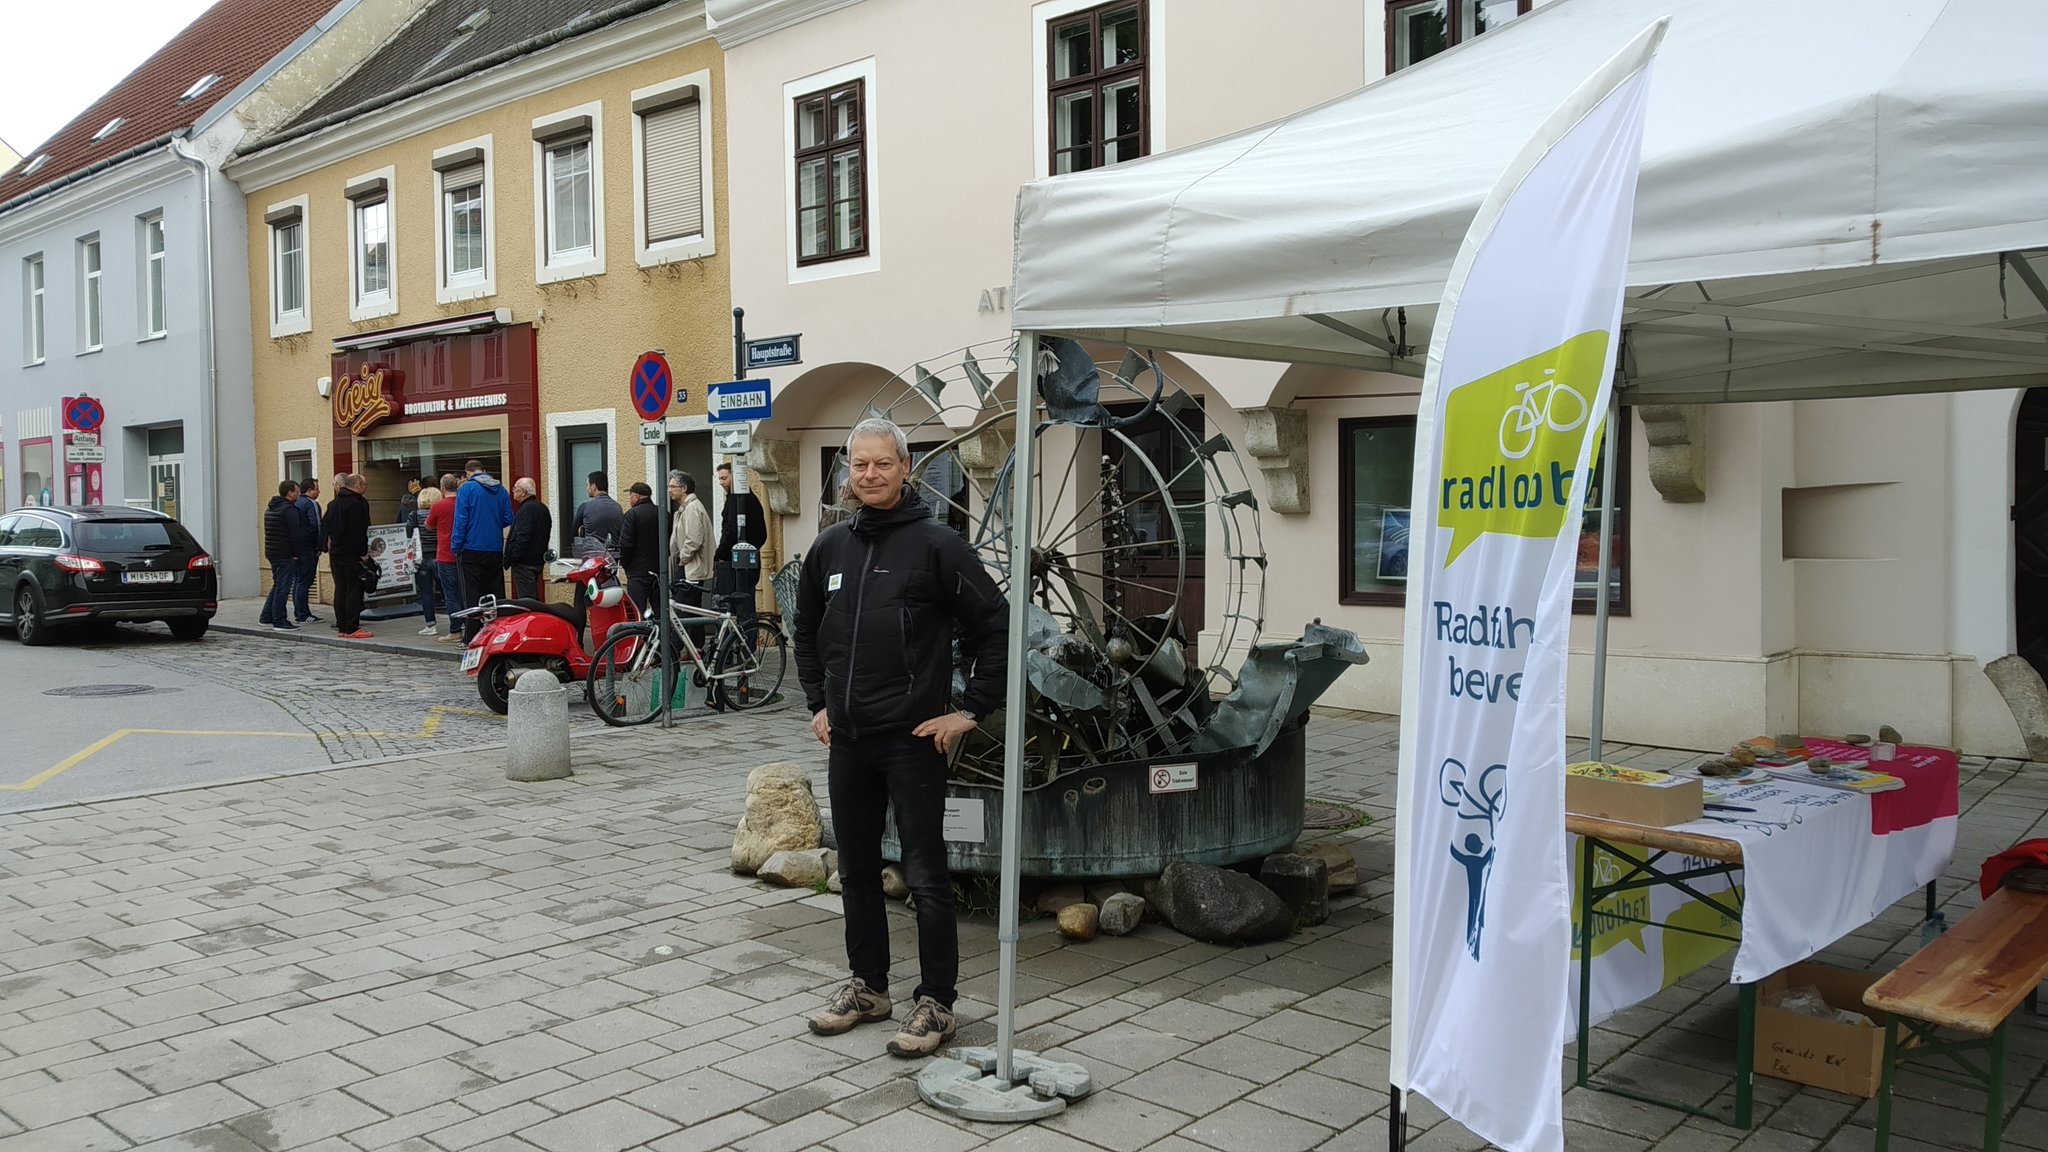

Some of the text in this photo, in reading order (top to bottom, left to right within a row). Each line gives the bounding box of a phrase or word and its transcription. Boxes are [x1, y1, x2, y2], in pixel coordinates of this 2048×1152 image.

[751, 343, 792, 362] Hauptstraße
[336, 361, 390, 435] Geier
[404, 393, 507, 415] BROTKULTUR & KAFFEEGENUSS
[720, 396, 762, 409] EINBAHN
[74, 435, 96, 443] Anfang
[643, 428, 660, 439] Ende
[130, 572, 139, 580] MI
